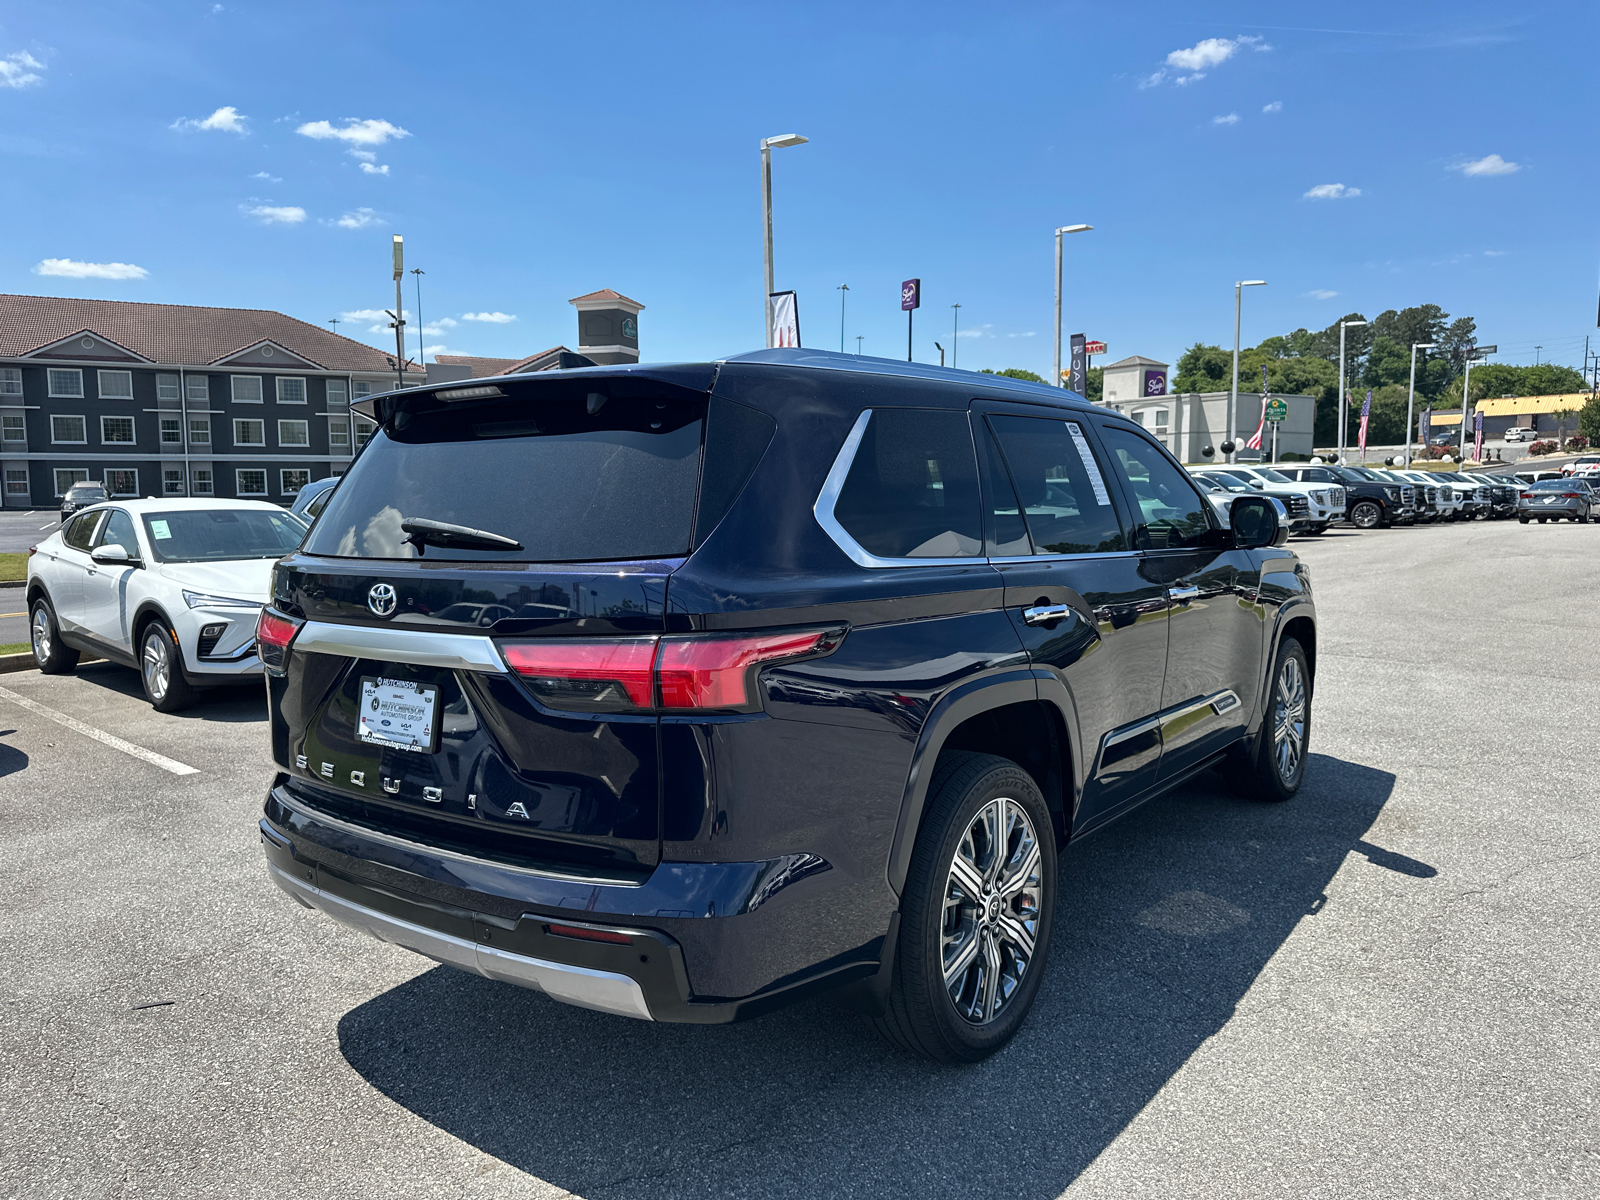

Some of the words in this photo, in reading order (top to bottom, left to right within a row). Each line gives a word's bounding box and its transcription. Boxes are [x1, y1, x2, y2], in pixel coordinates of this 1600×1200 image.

[382, 678, 418, 689] HUTCHINSON
[380, 701, 425, 715] HUTCHINSON
[381, 711, 407, 720] AUTOMOTIVE
[296, 754, 530, 819] SEQUOIA
